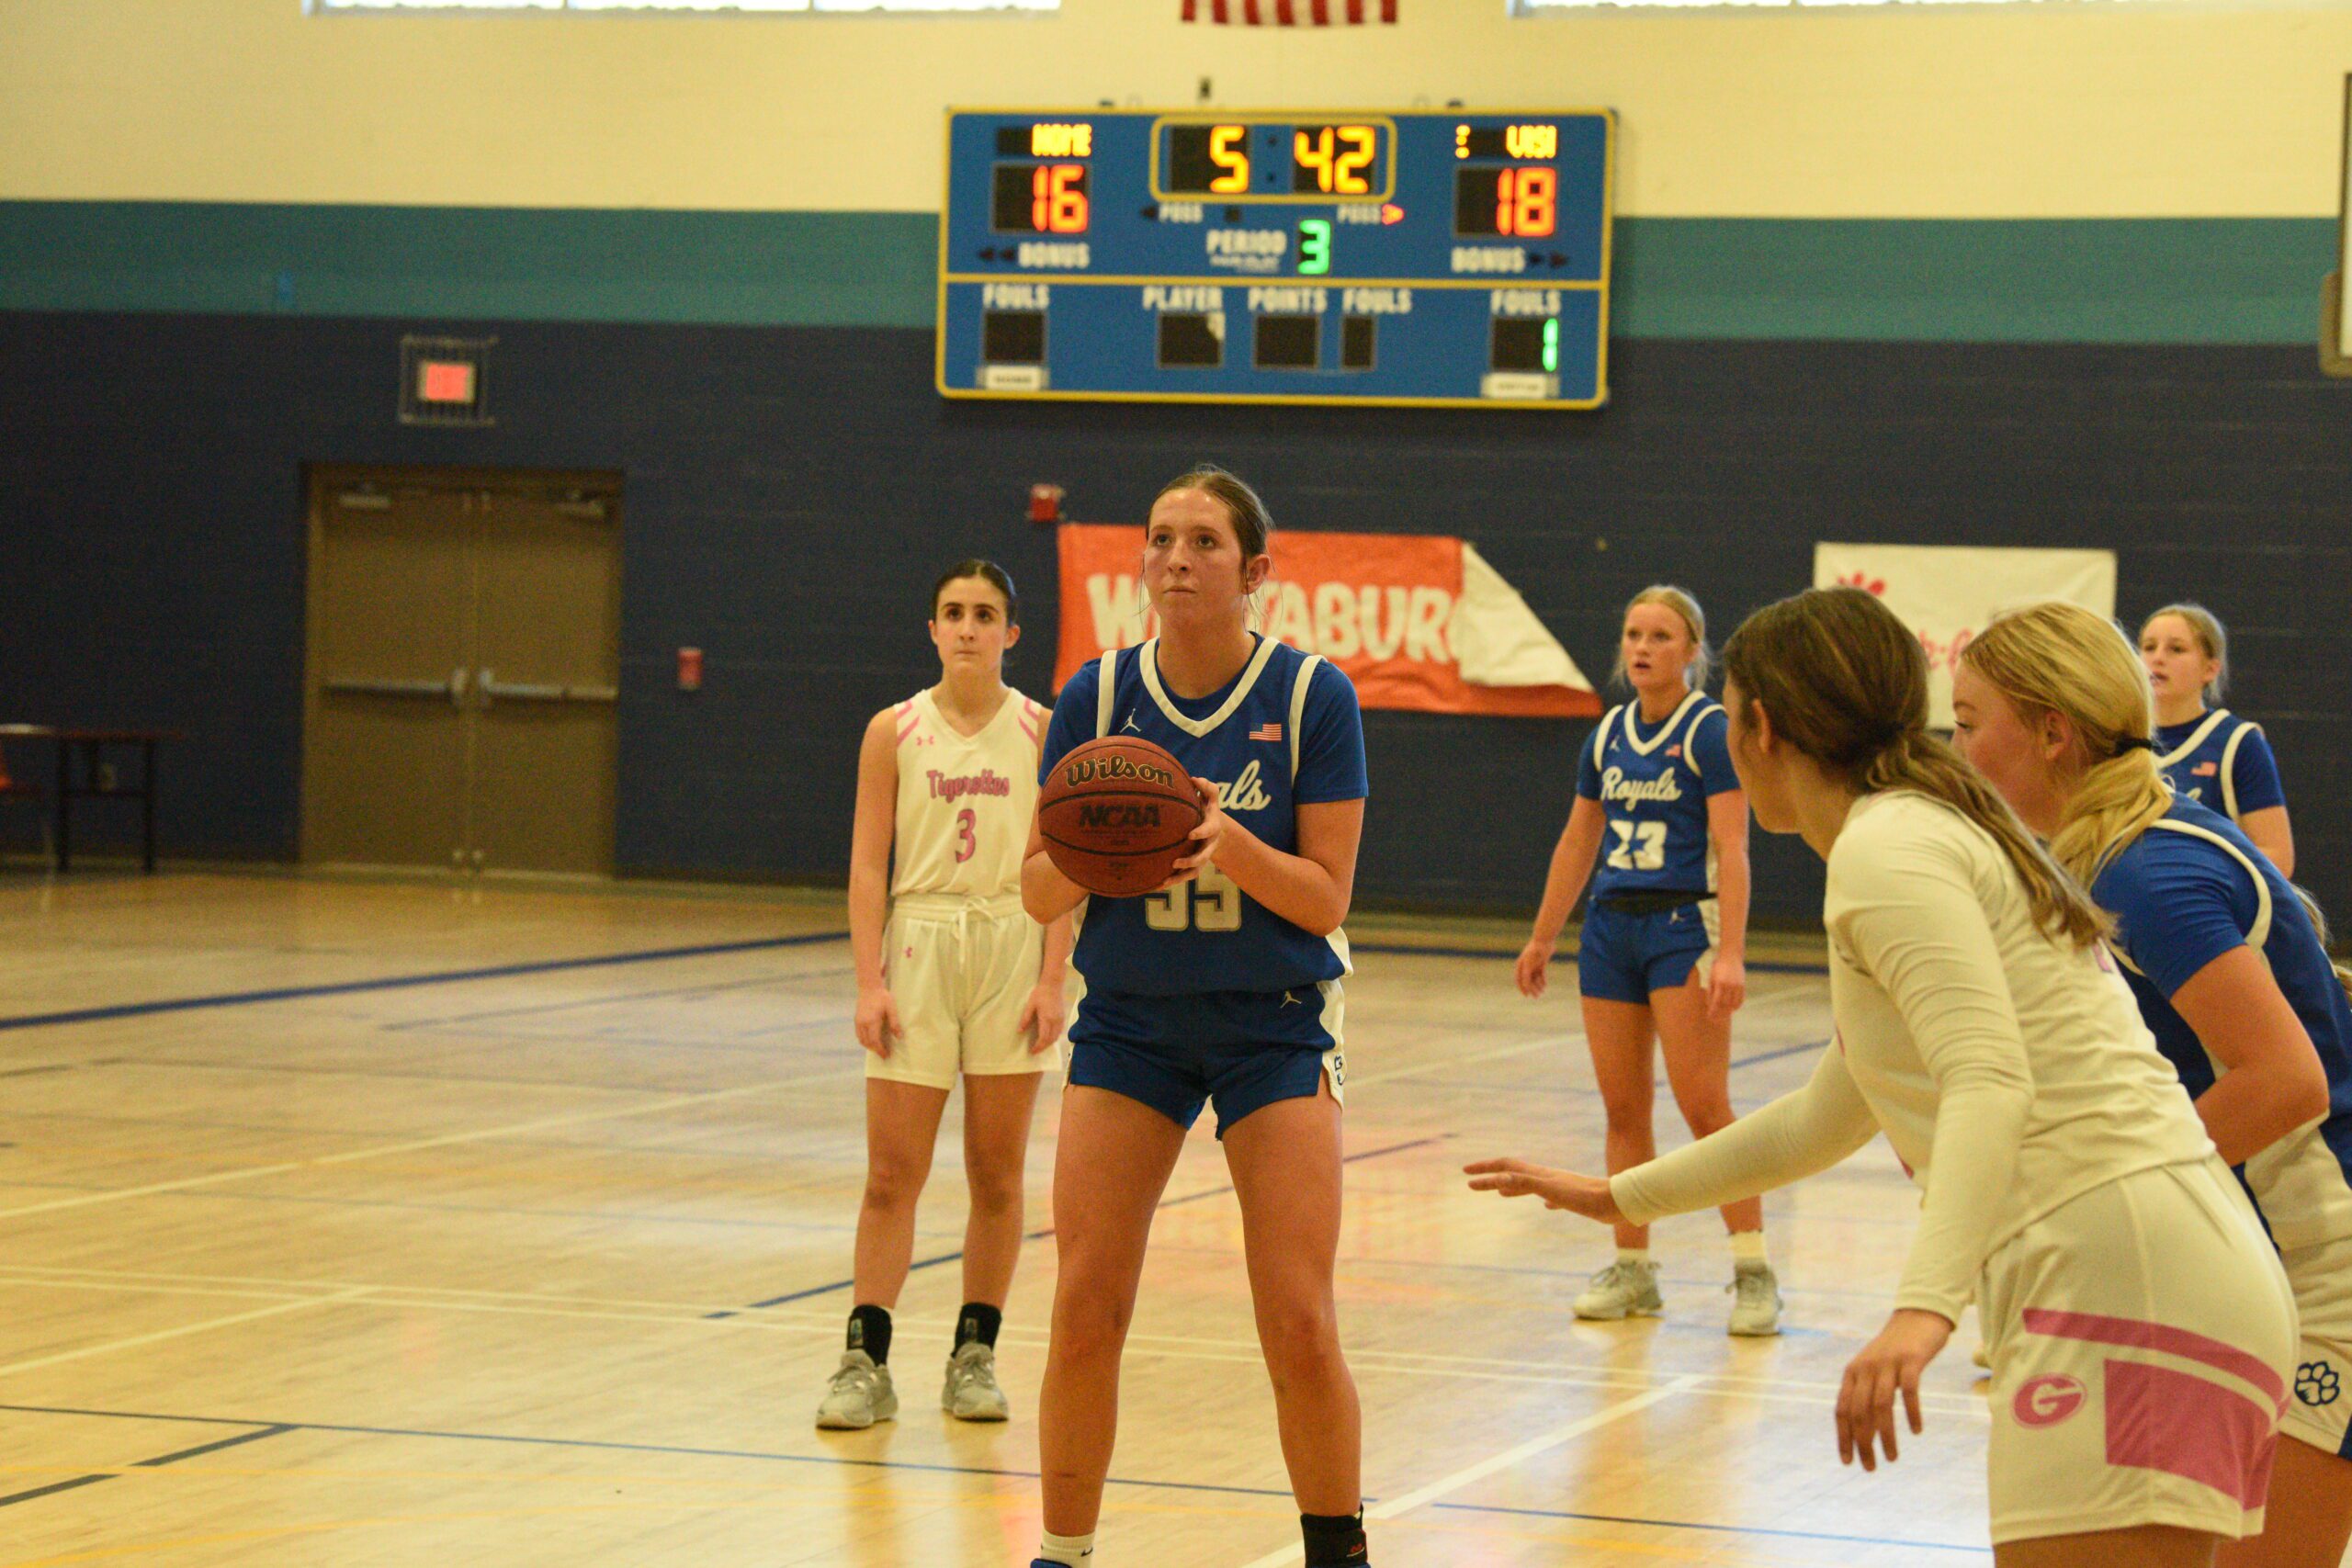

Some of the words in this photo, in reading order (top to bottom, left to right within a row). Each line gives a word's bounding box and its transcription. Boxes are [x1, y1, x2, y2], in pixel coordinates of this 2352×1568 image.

[1210, 125, 1250, 194] 5
[1294, 125, 1375, 195] 42
[1032, 164, 1089, 233] 16
[1497, 167, 1557, 237] 18
[1018, 242, 1090, 268] BONUS
[1206, 229, 1287, 255] PERIOD
[1297, 219, 1331, 275] 3
[1451, 246, 1525, 273] BONUS
[982, 283, 1049, 310] FOULS
[1142, 285, 1223, 310] PLAYER
[1248, 286, 1328, 313] POINTS
[1341, 288, 1412, 314] FOULS
[1489, 288, 1561, 316] FOULS
[1543, 318, 1558, 372] 1
[1064, 755, 1175, 790] Wilson
[1600, 766, 1682, 812] Royals
[1079, 803, 1162, 828] NCAA
[956, 808, 977, 864] 3
[1607, 819, 1668, 870] 23
